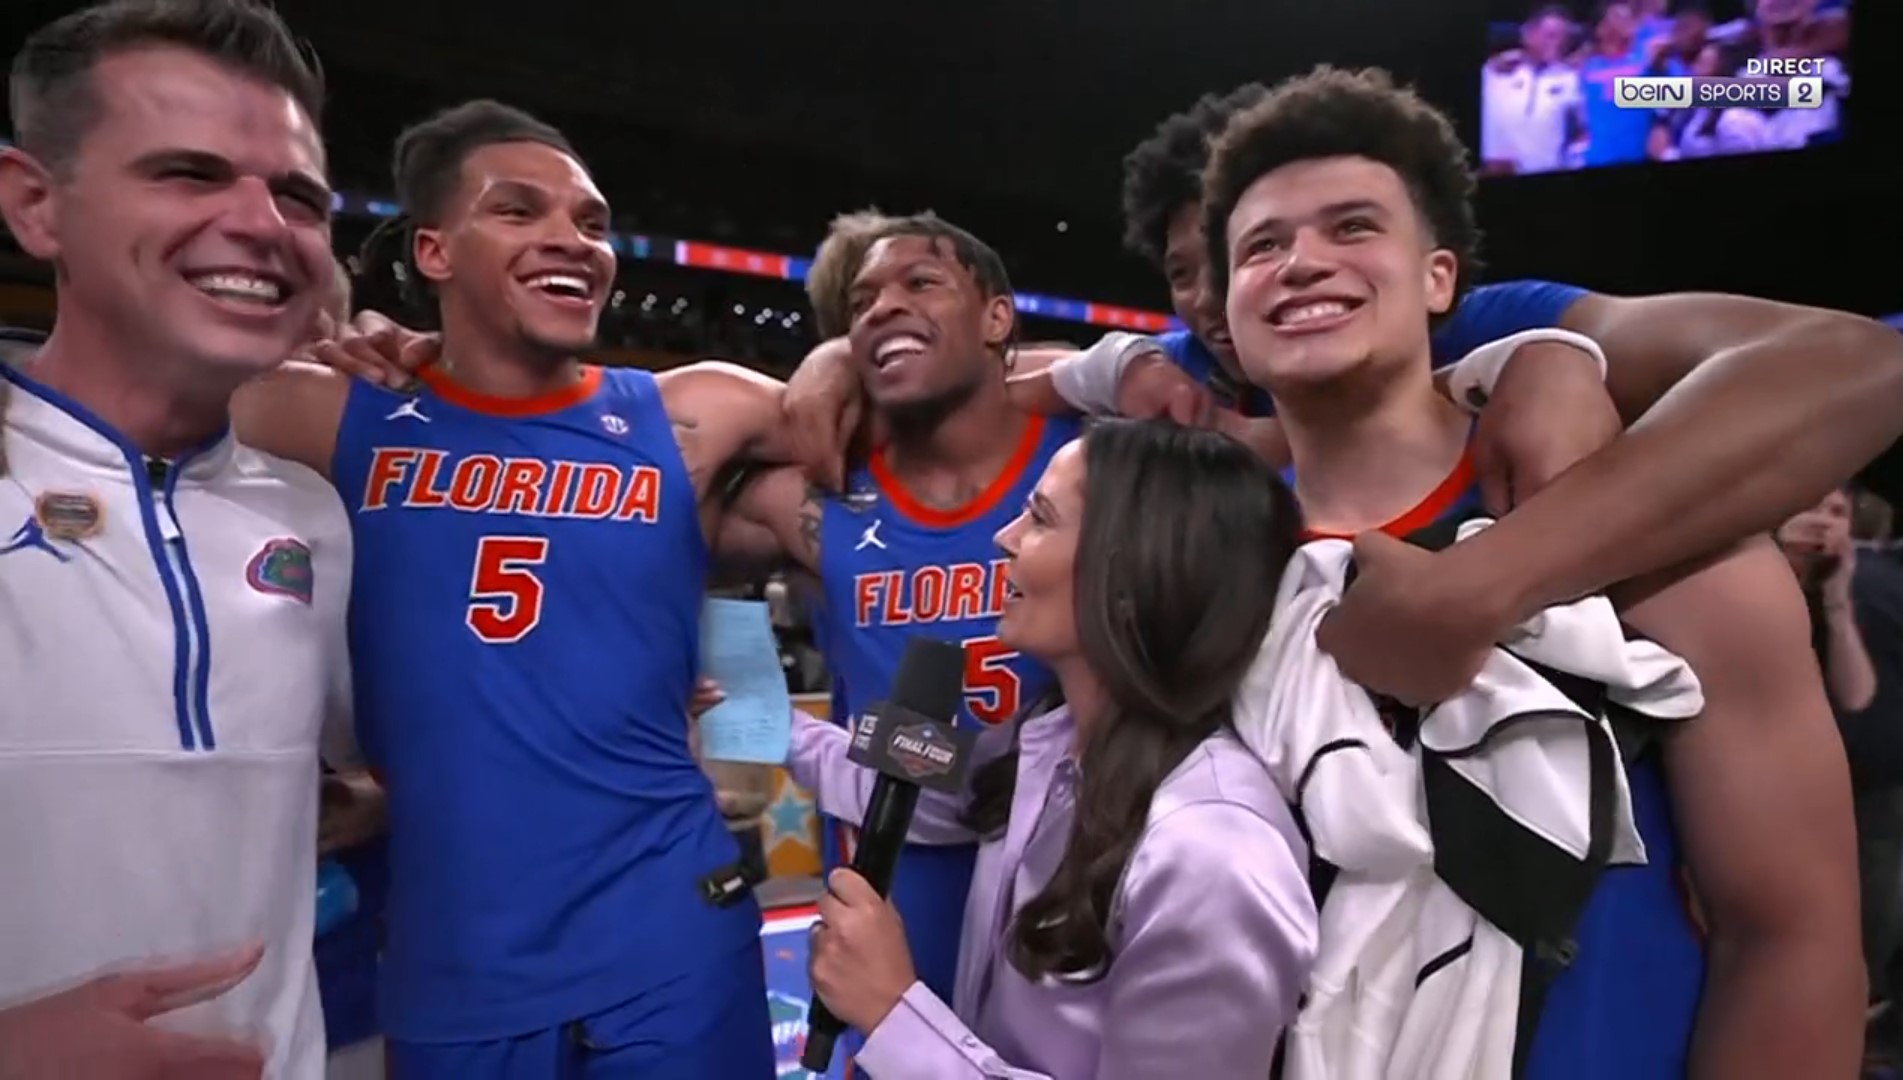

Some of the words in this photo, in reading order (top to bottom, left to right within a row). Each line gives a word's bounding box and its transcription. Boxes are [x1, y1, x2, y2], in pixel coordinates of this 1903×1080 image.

[358, 447, 662, 524] FLORIDA
[465, 535, 549, 643] 5
[952, 636, 1020, 729] 5
